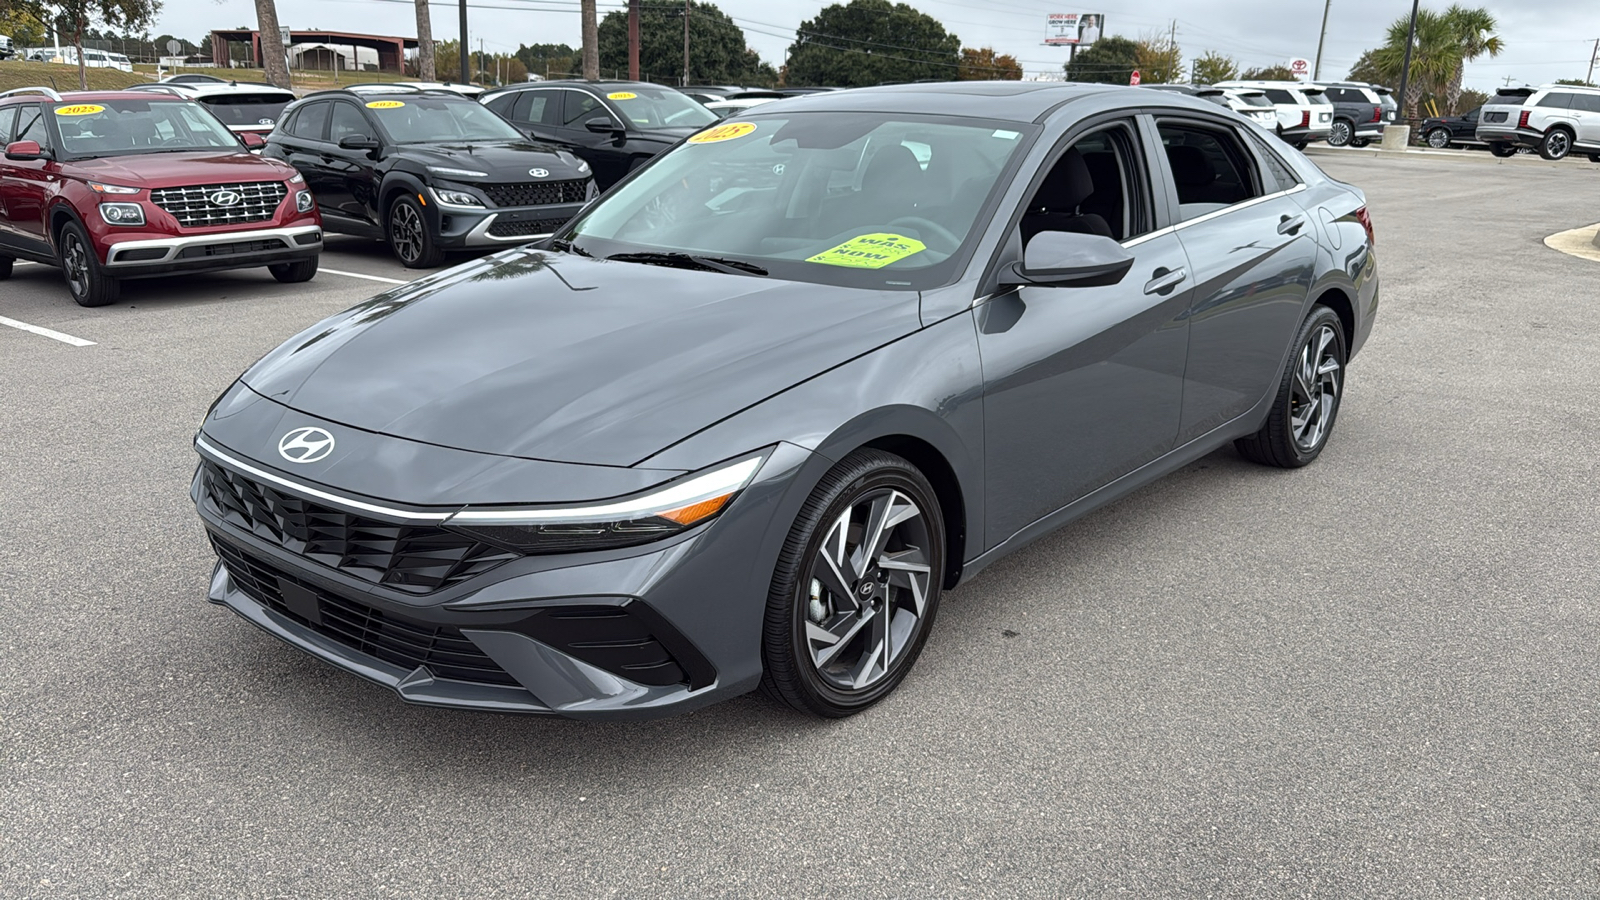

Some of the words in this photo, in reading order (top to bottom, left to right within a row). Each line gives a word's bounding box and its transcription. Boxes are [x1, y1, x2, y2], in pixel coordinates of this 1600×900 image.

[64, 106, 96, 114] 2025
[693, 125, 750, 141] 2025
[858, 238, 911, 250] WAS
[832, 249, 891, 260] NOW
